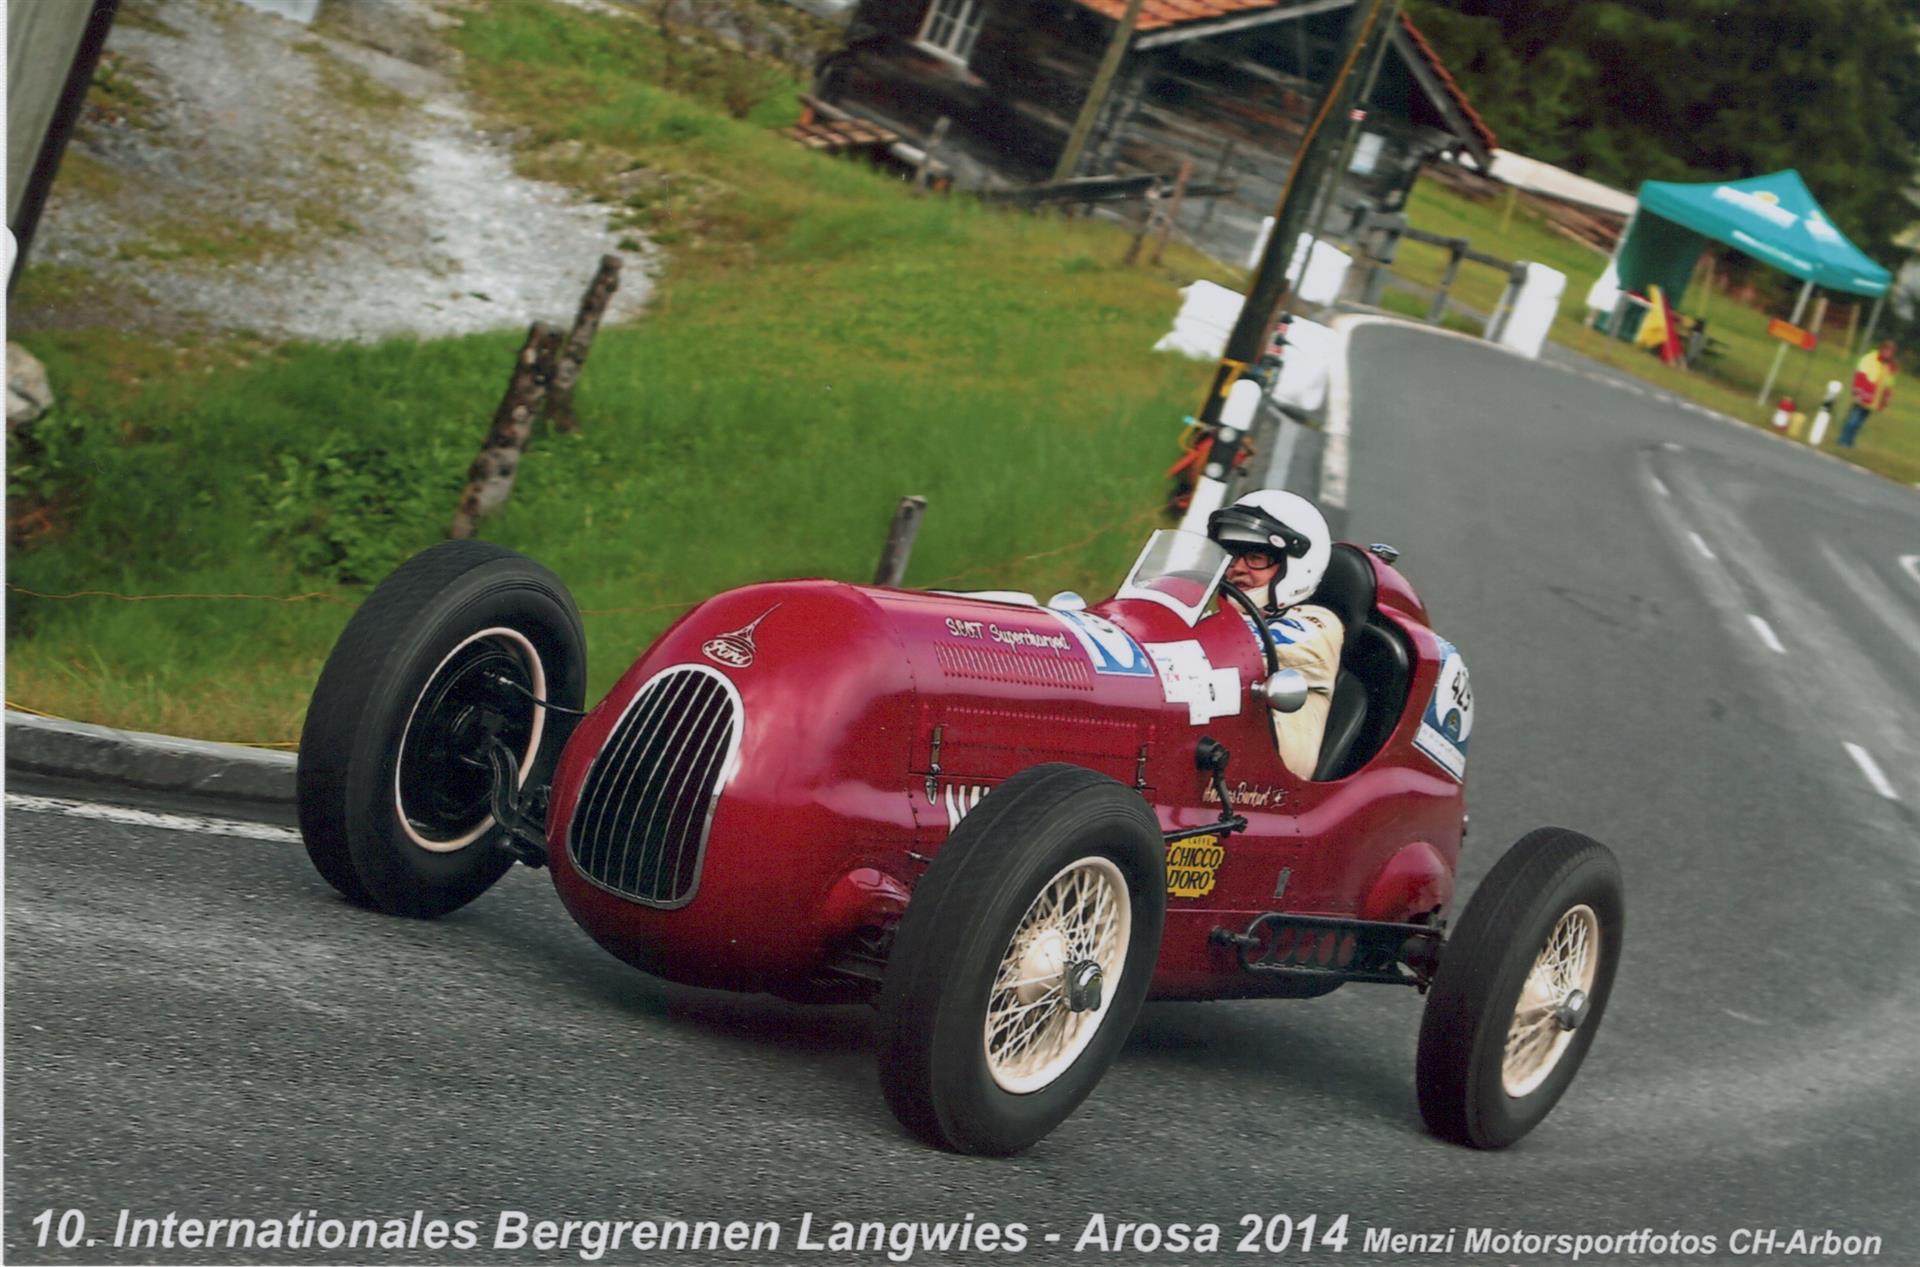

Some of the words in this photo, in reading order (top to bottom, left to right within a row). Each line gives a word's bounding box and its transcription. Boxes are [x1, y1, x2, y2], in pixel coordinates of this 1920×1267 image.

[703, 640, 750, 665] Ford
[988, 623, 1072, 658] Supercharged
[1169, 846, 1222, 868] CHICCO
